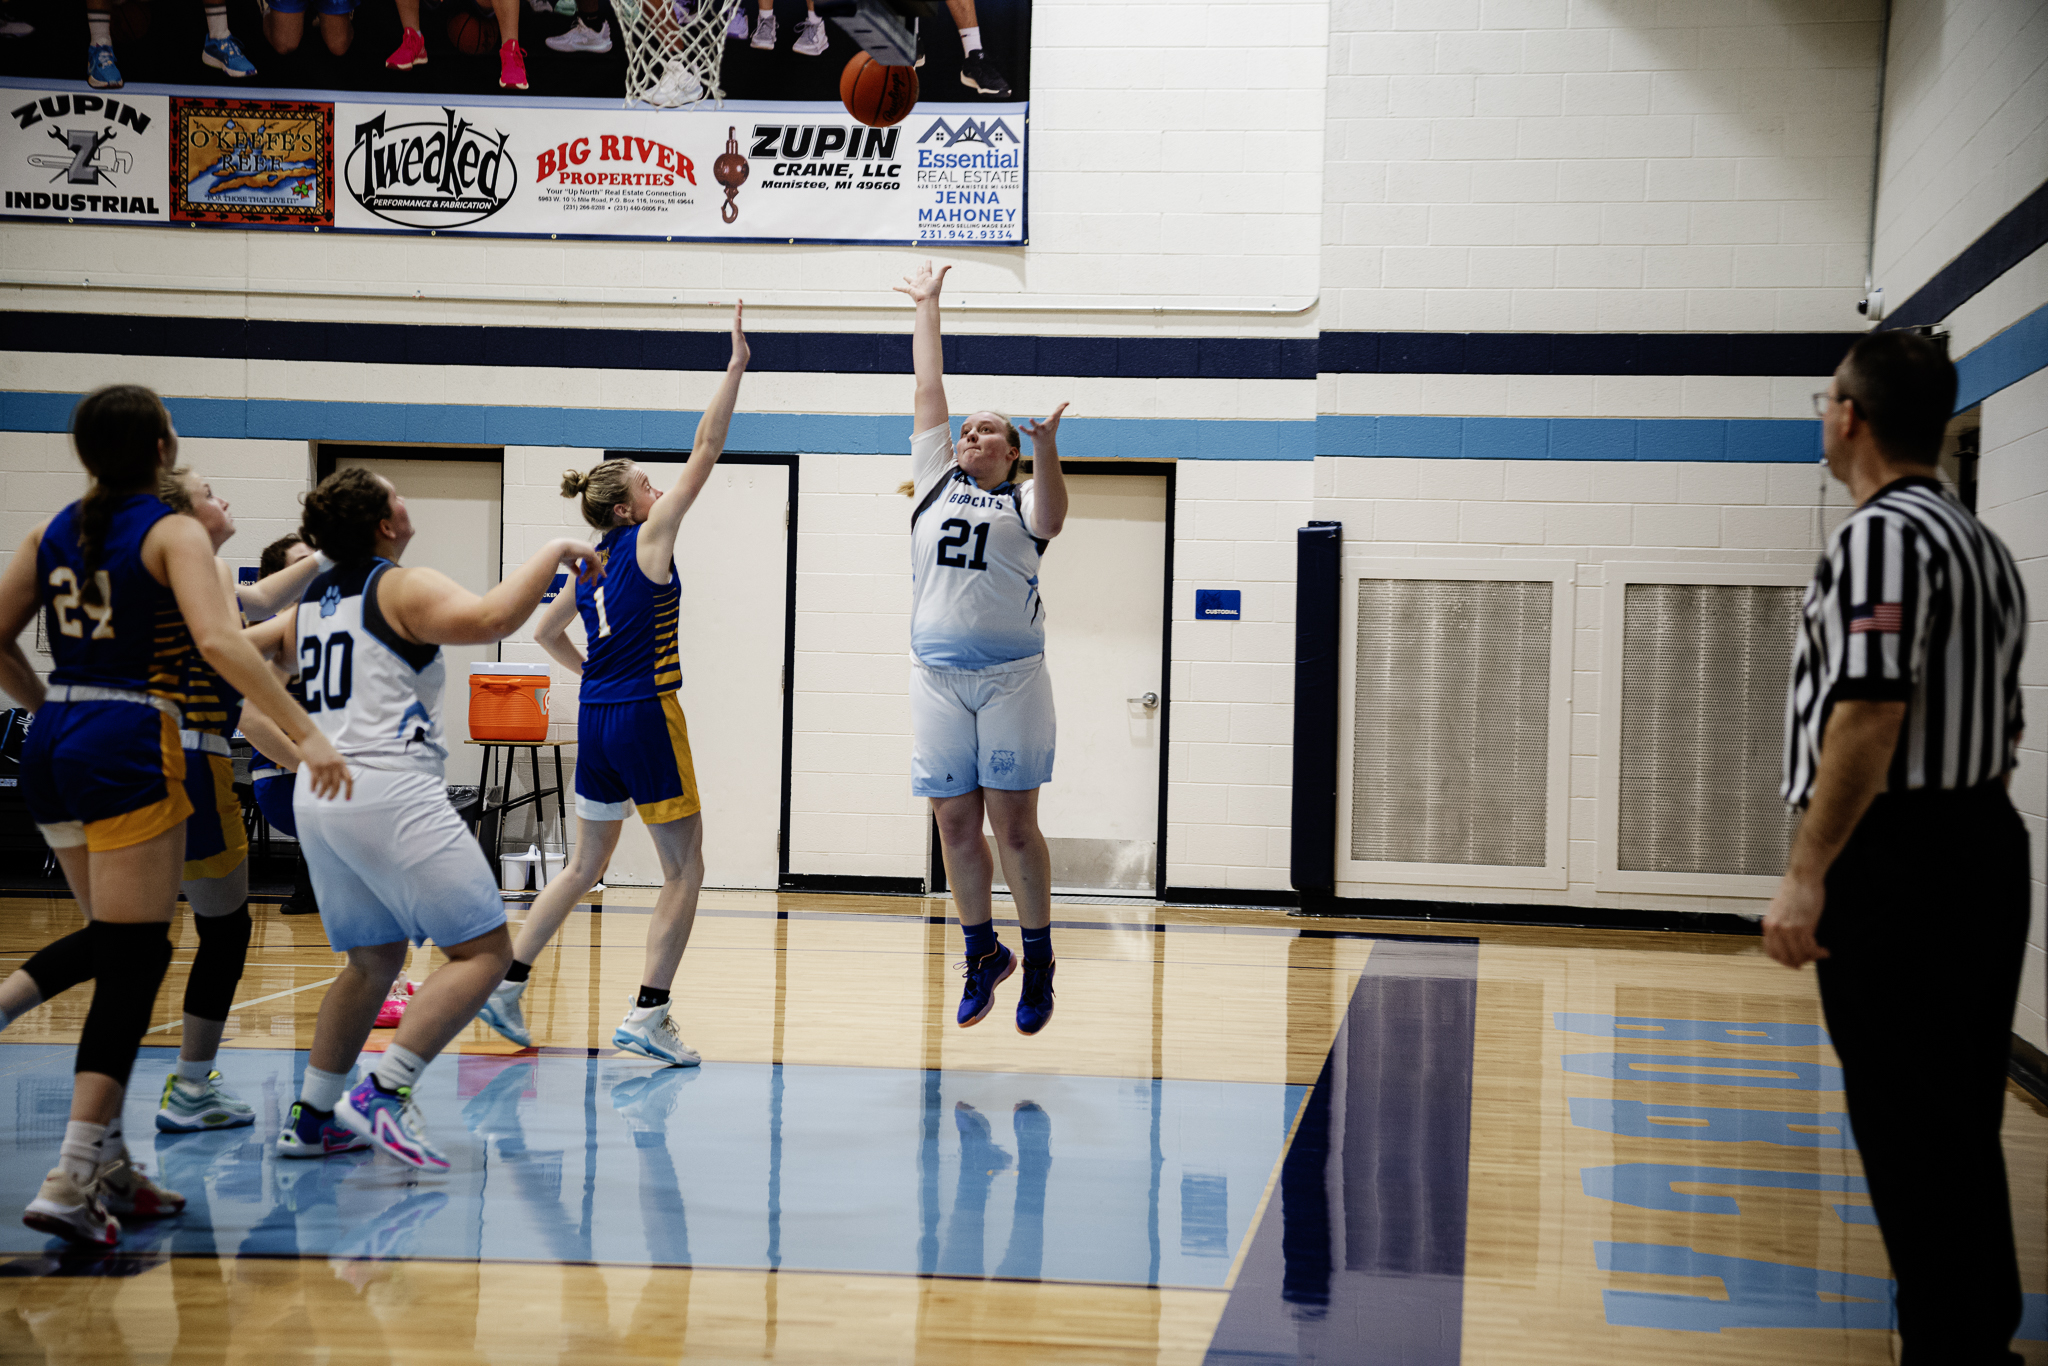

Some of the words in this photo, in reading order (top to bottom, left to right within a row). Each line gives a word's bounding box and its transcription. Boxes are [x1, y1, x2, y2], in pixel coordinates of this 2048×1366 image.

[10, 94, 151, 135] ZUPIN
[190, 130, 312, 152] O'KEEFE'S
[748, 124, 902, 161] ZUPIN
[67, 129, 98, 185] Z
[222, 153, 284, 172] REEF
[355, 106, 510, 206] Tweaked
[536, 137, 591, 183] BIG
[599, 135, 697, 186] RIVER
[917, 148, 1019, 169] Essential
[559, 172, 675, 186] PROPERTIES
[773, 163, 854, 179] CRANE,
[862, 164, 902, 178] LLC
[917, 170, 958, 183] REAL
[963, 170, 1019, 183] ESTATE
[546, 187, 563, 195] Your
[761, 180, 830, 191] Manistee,
[834, 181, 852, 189] MI
[856, 181, 901, 190] 49660
[5, 191, 159, 214] INDUSTRIAL
[373, 198, 431, 208] PERFORMANCE
[432, 200, 439, 208] &
[440, 200, 492, 210] FABRICATION
[935, 191, 1000, 204] JENNA
[918, 208, 1017, 222] MAHONEY
[920, 230, 1013, 239] 231.942.9334
[949, 492, 1003, 510] BOBCATS
[937, 518, 990, 571] 21
[593, 585, 612, 638] 1
[299, 631, 354, 714] 20
